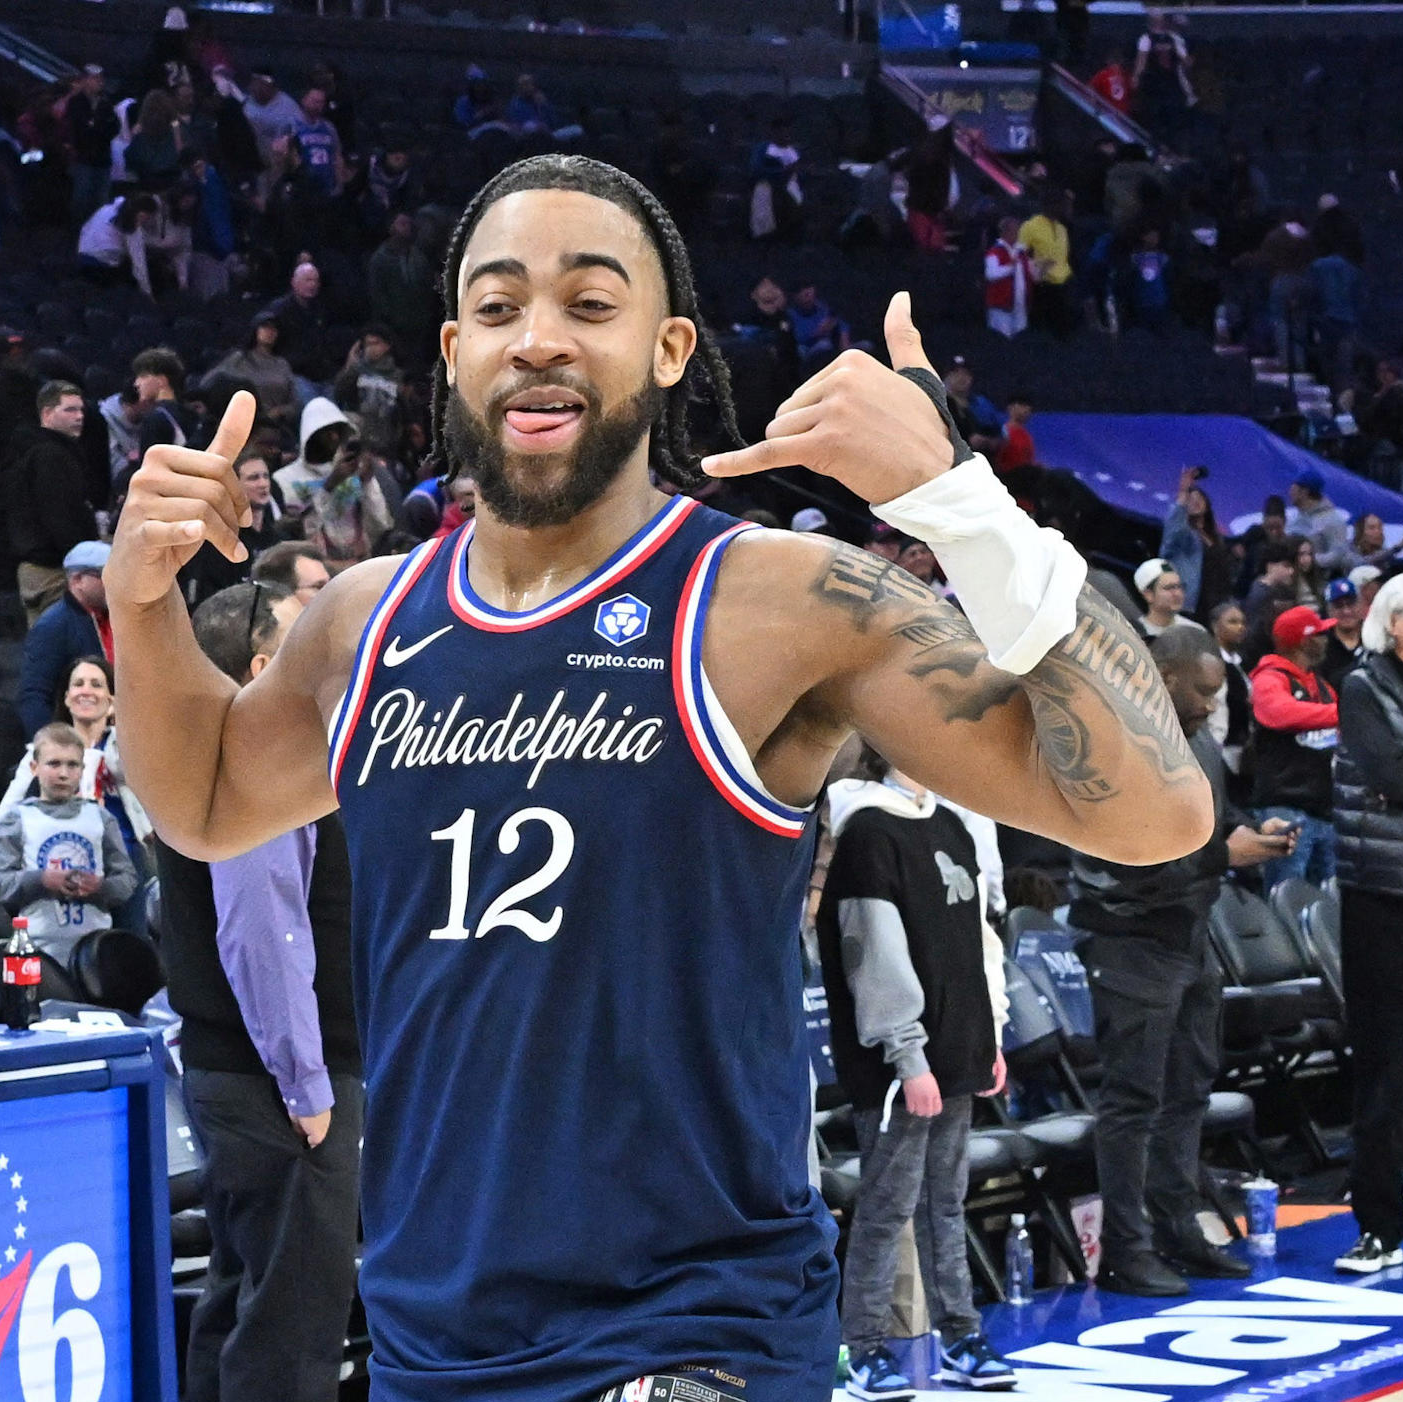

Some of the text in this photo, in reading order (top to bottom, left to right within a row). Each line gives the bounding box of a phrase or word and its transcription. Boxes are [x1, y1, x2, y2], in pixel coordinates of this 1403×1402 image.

[565, 651, 665, 671] crypto.com
[357, 687, 665, 790] Philadelphia
[428, 806, 575, 943] 12
[654, 1386, 667, 1398] 50
